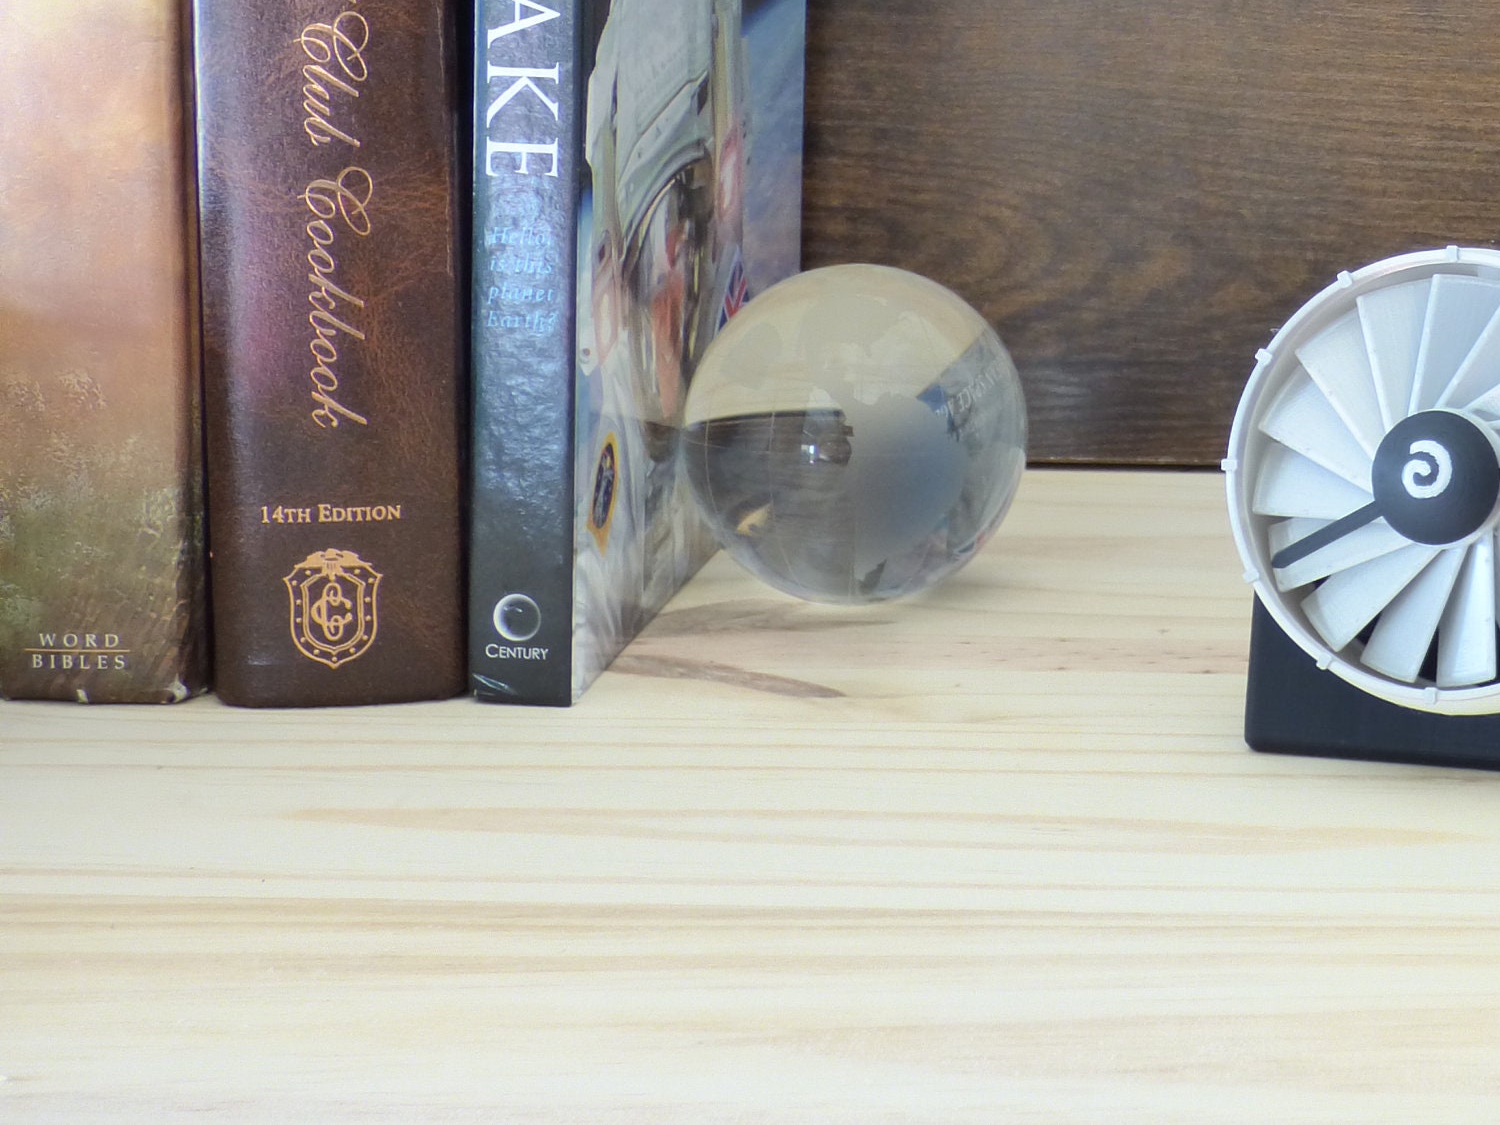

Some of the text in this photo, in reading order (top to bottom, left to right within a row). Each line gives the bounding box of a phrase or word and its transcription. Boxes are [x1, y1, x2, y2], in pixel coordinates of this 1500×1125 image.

[293, 10, 370, 147] Club
[297, 166, 374, 430] Cookbook
[261, 503, 401, 524] 14TH EDITION
[38, 633, 120, 648] WORD
[32, 653, 126, 670] BIBLES
[485, 643, 549, 661] CENTURY
